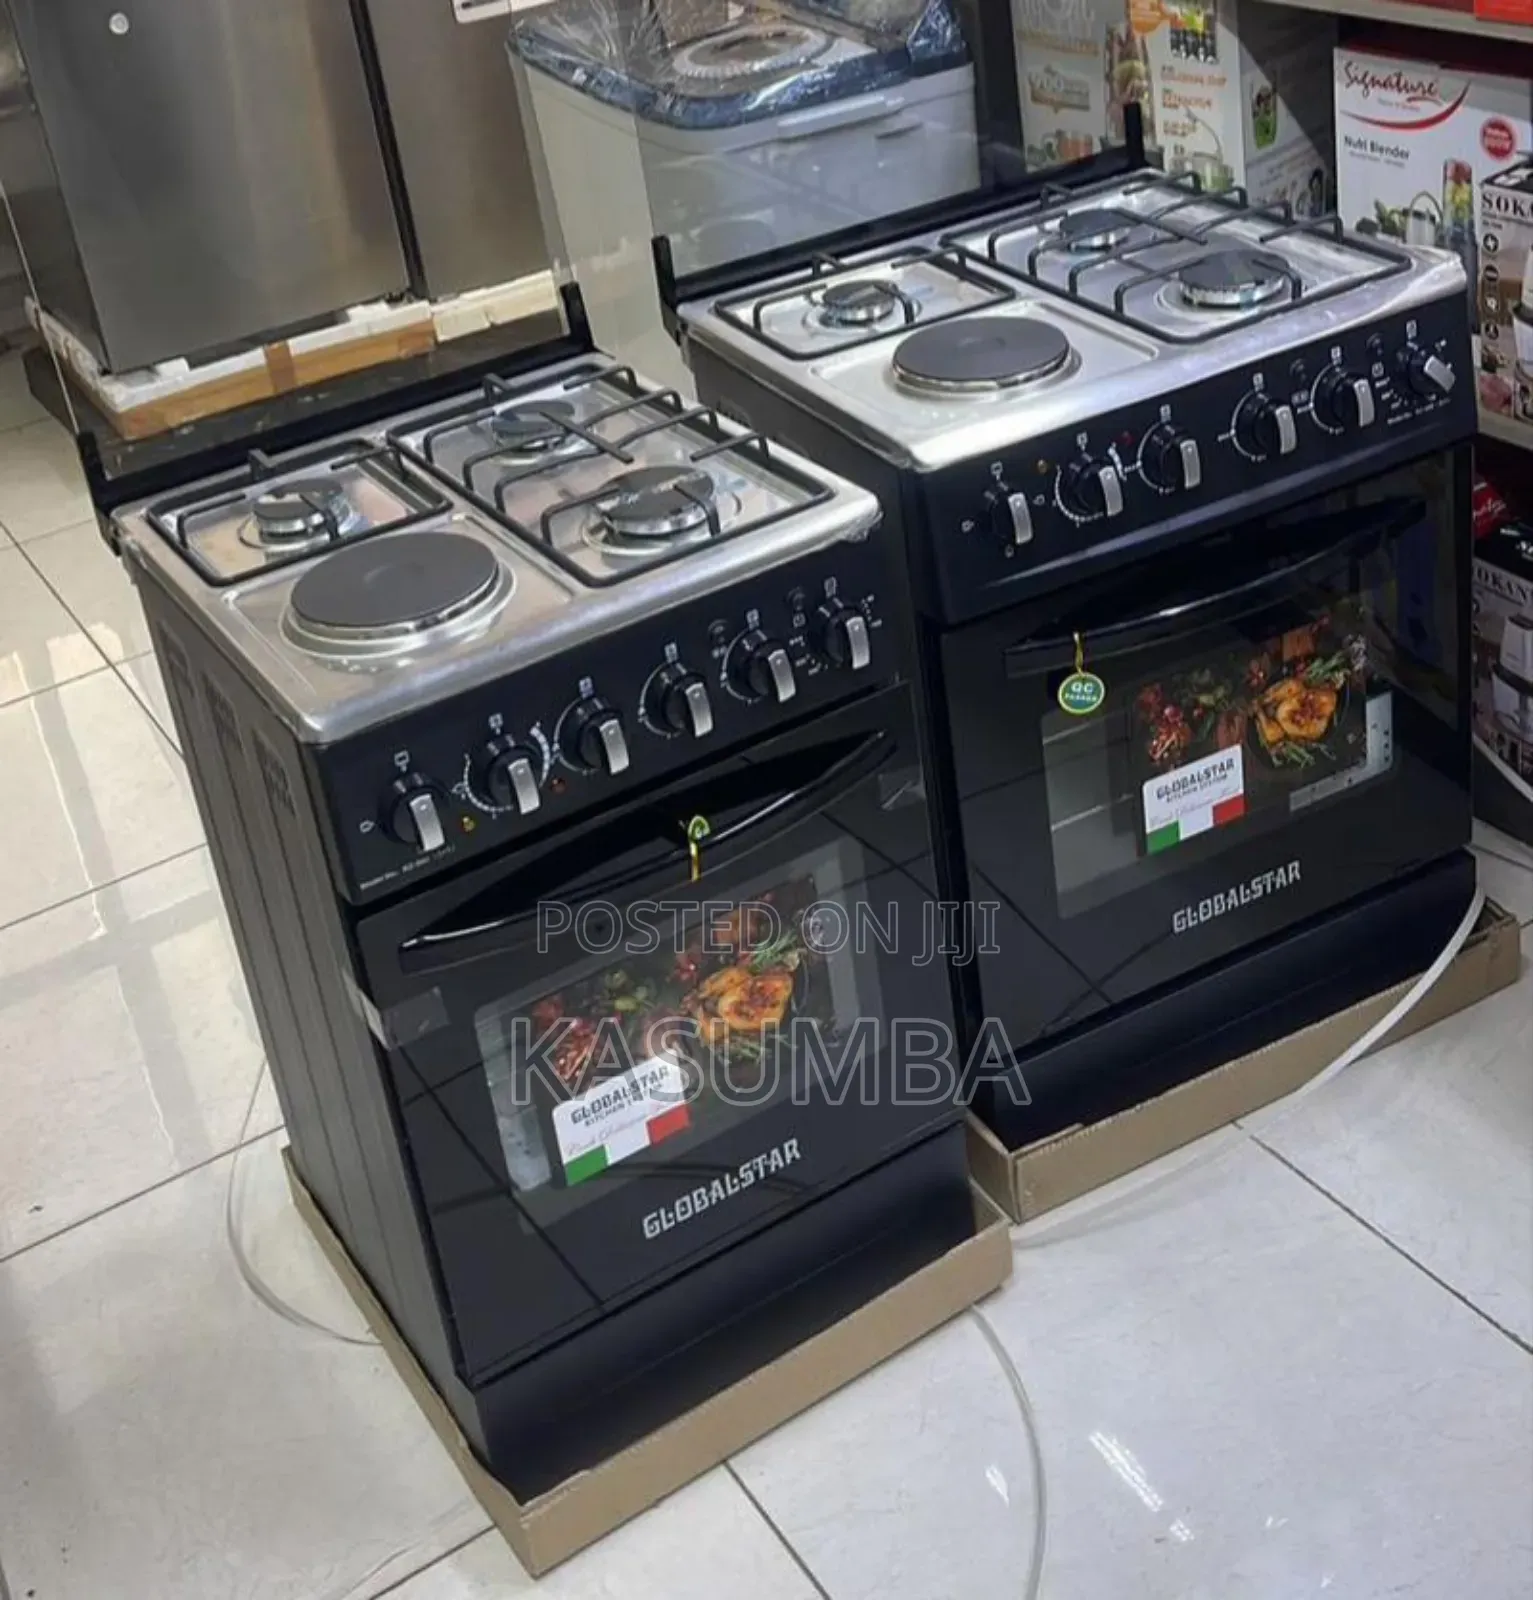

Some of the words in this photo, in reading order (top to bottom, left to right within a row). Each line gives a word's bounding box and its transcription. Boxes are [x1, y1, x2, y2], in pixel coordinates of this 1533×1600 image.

[1344, 60, 1440, 98] Signature
[1370, 141, 1411, 161] Blender
[1071, 682, 1094, 695] QC
[1156, 757, 1235, 799] GLOBALSTAR
[1172, 860, 1301, 934] GLOBALSTAR
[570, 1064, 671, 1125] GLOBALSTAR
[642, 1137, 802, 1240] GLOBALSTAR
